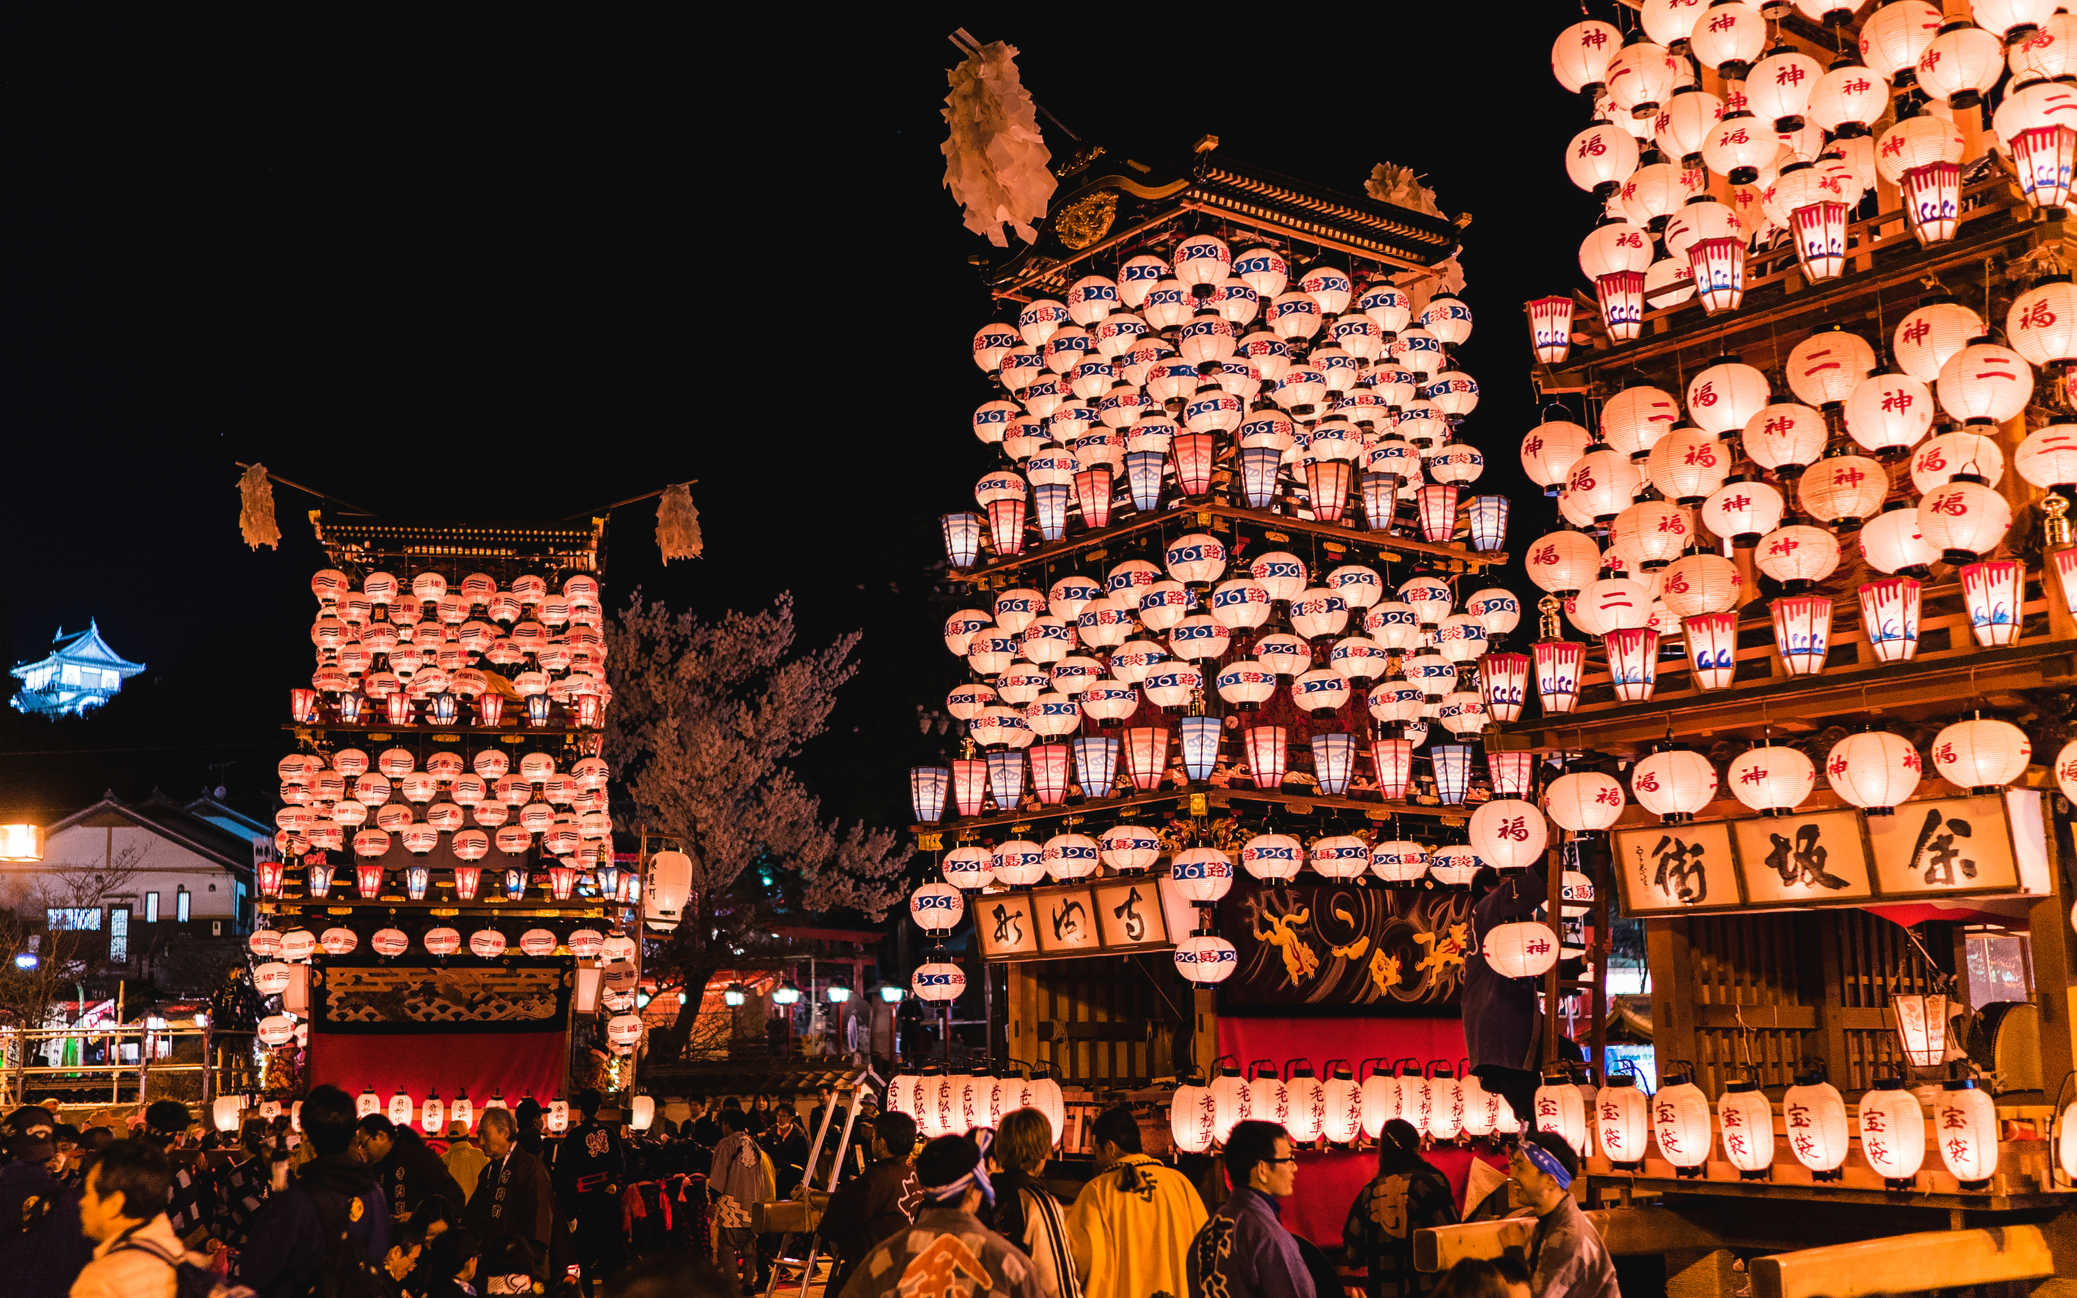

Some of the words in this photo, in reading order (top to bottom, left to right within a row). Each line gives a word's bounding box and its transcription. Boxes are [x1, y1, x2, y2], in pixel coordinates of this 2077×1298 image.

[1708, 13, 1736, 33] 神
[1581, 28, 1608, 51] 神
[1607, 58, 1631, 86] 二
[1920, 49, 1942, 73] 神
[1776, 63, 1806, 89] 神
[1842, 77, 1870, 96] 神
[1655, 112, 1670, 134] 神
[1578, 133, 1607, 159] 福
[1720, 128, 1750, 148] 福
[1882, 135, 1906, 158] 神
[1616, 232, 1643, 249] 福
[1668, 220, 1690, 244] 二
[2019, 299, 2057, 330] 福
[1903, 318, 1930, 347] 神
[1805, 350, 1840, 377] 二
[1976, 358, 2016, 381] 二
[1692, 381, 1718, 408] 福
[1881, 389, 1913, 416] 神
[1647, 402, 1675, 422] 二
[1763, 415, 1794, 438] 神
[1524, 435, 1544, 459] 神
[1684, 443, 1718, 468] 福
[1916, 447, 1946, 474] 福
[1570, 466, 1596, 493] 福
[1834, 467, 1864, 488] 神
[1722, 494, 1751, 513] 神
[1931, 492, 1968, 517] 福
[1658, 514, 1686, 536] 福
[1533, 544, 1560, 566] 福
[1769, 537, 1799, 557] 神
[1664, 572, 1690, 595] 福
[1600, 592, 1633, 610] 二
[1935, 741, 1958, 765] 福
[1740, 765, 1768, 786] 神
[1829, 754, 1848, 780] 神
[1635, 771, 1660, 792] 福
[1596, 787, 1621, 807] 福
[1497, 815, 1529, 842] 福
[1207, 862, 1227, 878] 路
[1526, 938, 1550, 955] 神
[1309, 1085, 1324, 1135] 老松車
[1344, 1085, 1362, 1135] 老松車
[1416, 1083, 1432, 1130] 老松車
[1450, 1085, 1464, 1131] 老松車
[1196, 1094, 1215, 1144] 老松車
[1600, 1102, 1622, 1150] 宝袋
[1655, 1101, 1682, 1154] 宝袋
[1722, 1107, 1747, 1155] 宝袋
[1788, 1103, 1820, 1159] 宝袋
[1863, 1107, 1894, 1165] 宝袋
[1942, 1106, 1970, 1163] 宝袋
